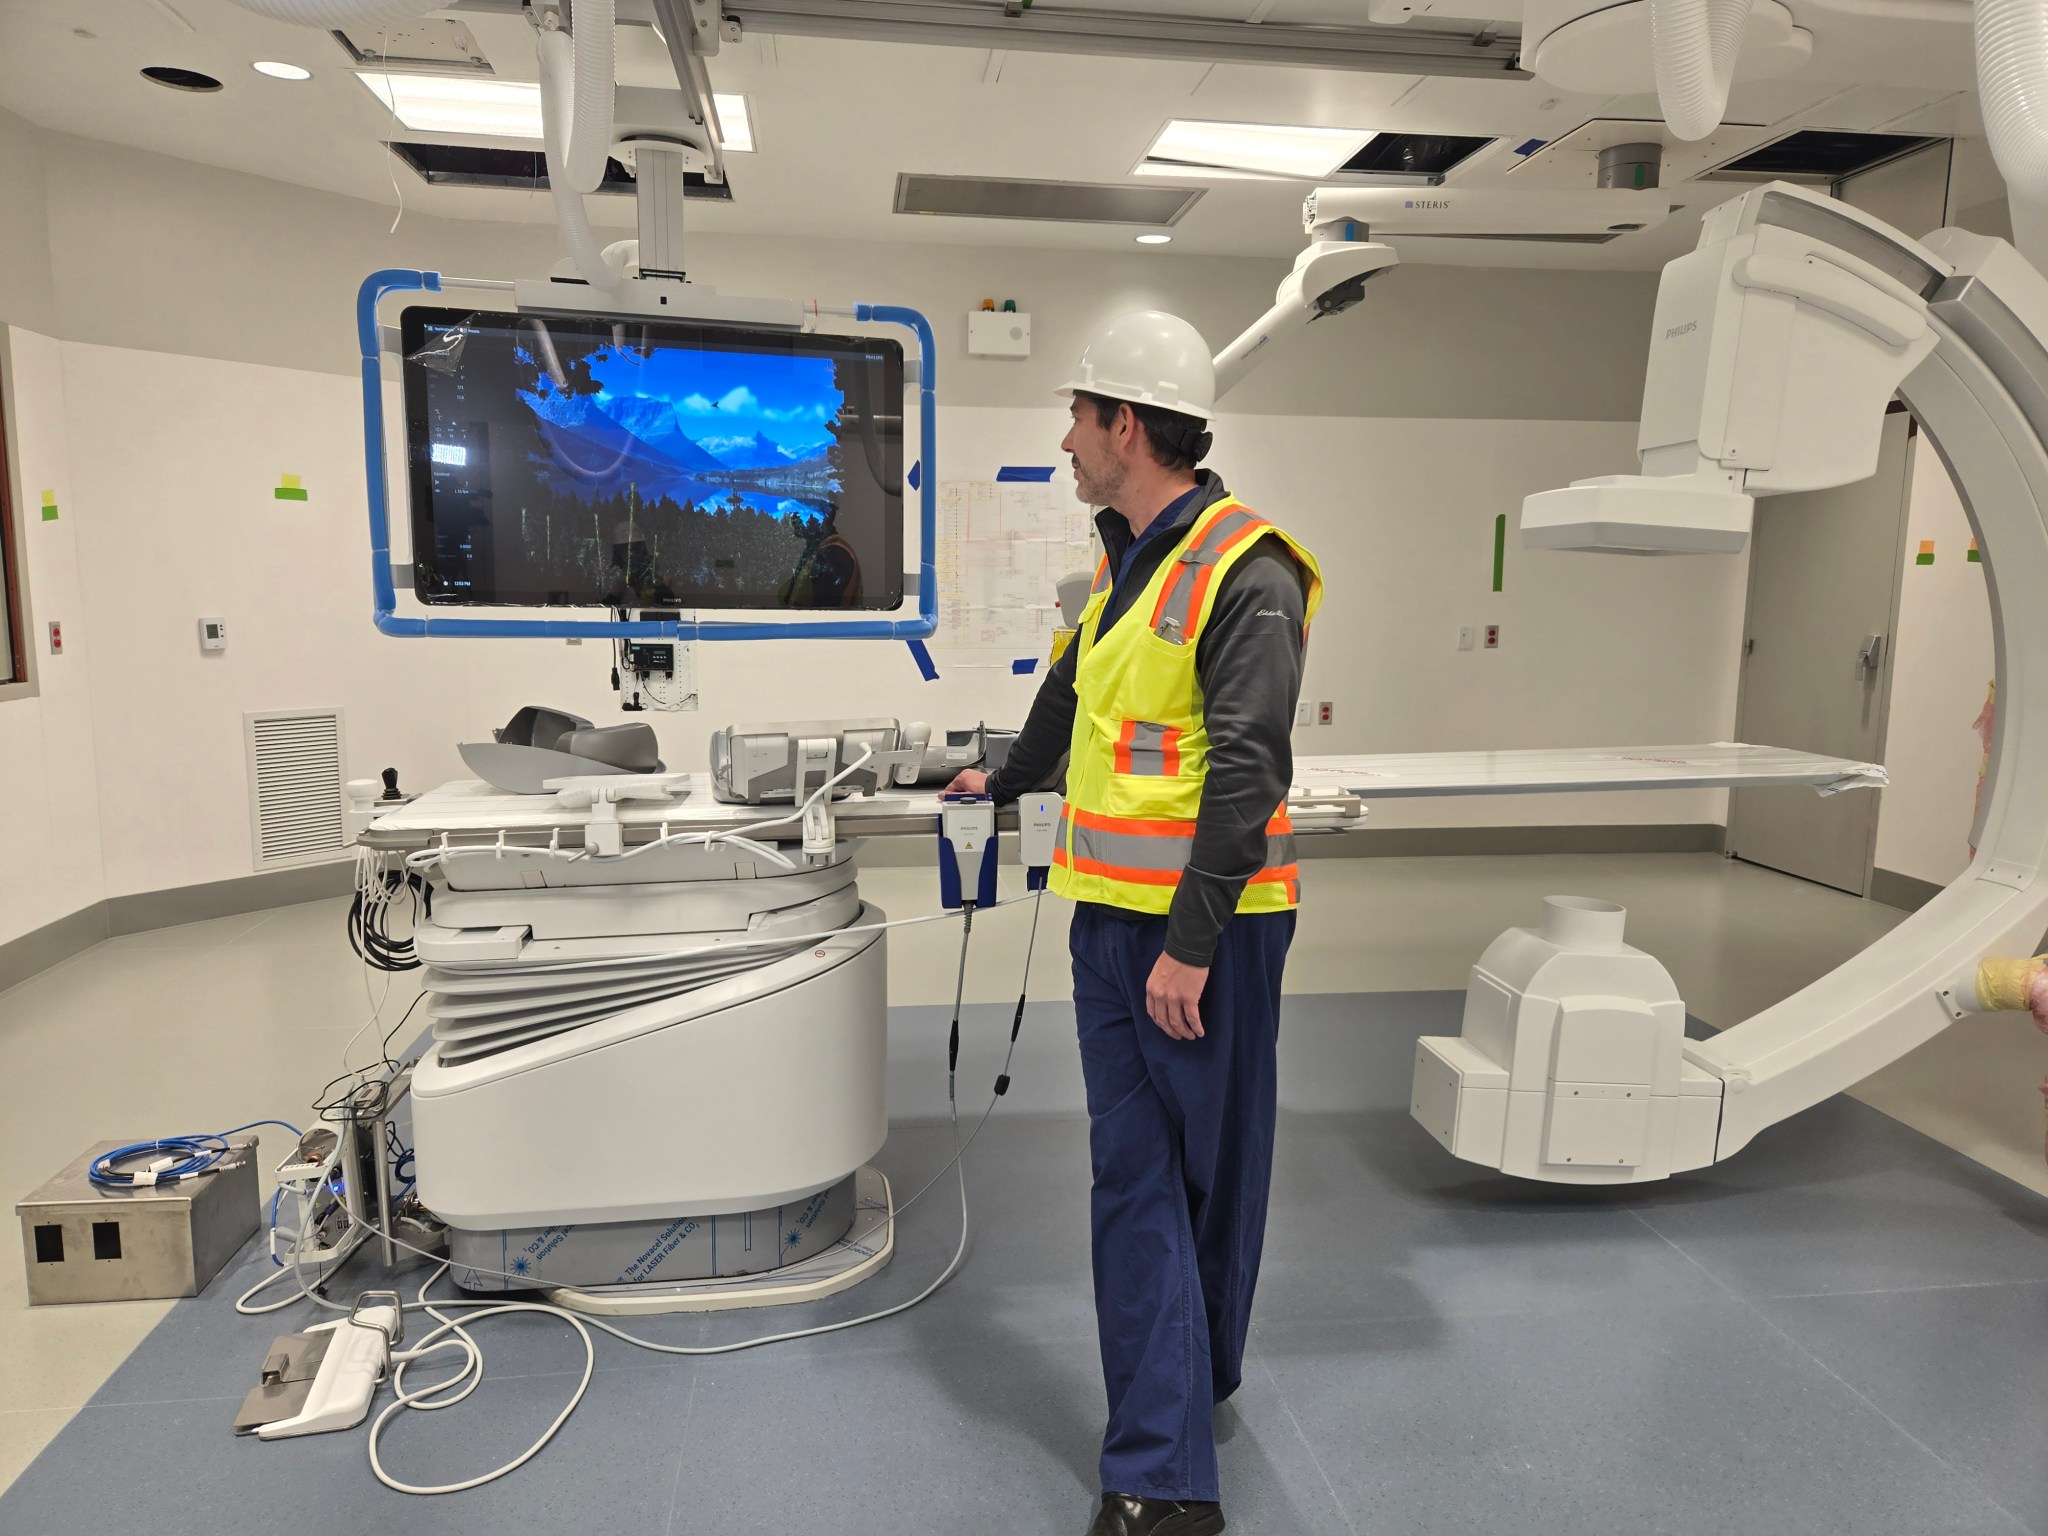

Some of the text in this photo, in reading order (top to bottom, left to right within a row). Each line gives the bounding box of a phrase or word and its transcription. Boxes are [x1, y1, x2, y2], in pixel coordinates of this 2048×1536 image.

[1415, 201, 1449, 209] STERIS
[1665, 320, 1697, 340] PHILIPS
[536, 1234, 564, 1260] Solution
[537, 1236, 545, 1244] &
[624, 1217, 688, 1276] The Novacel Solution
[642, 1252, 666, 1275] LASER
[662, 1237, 681, 1255] Fiber
[679, 1231, 687, 1239] &
